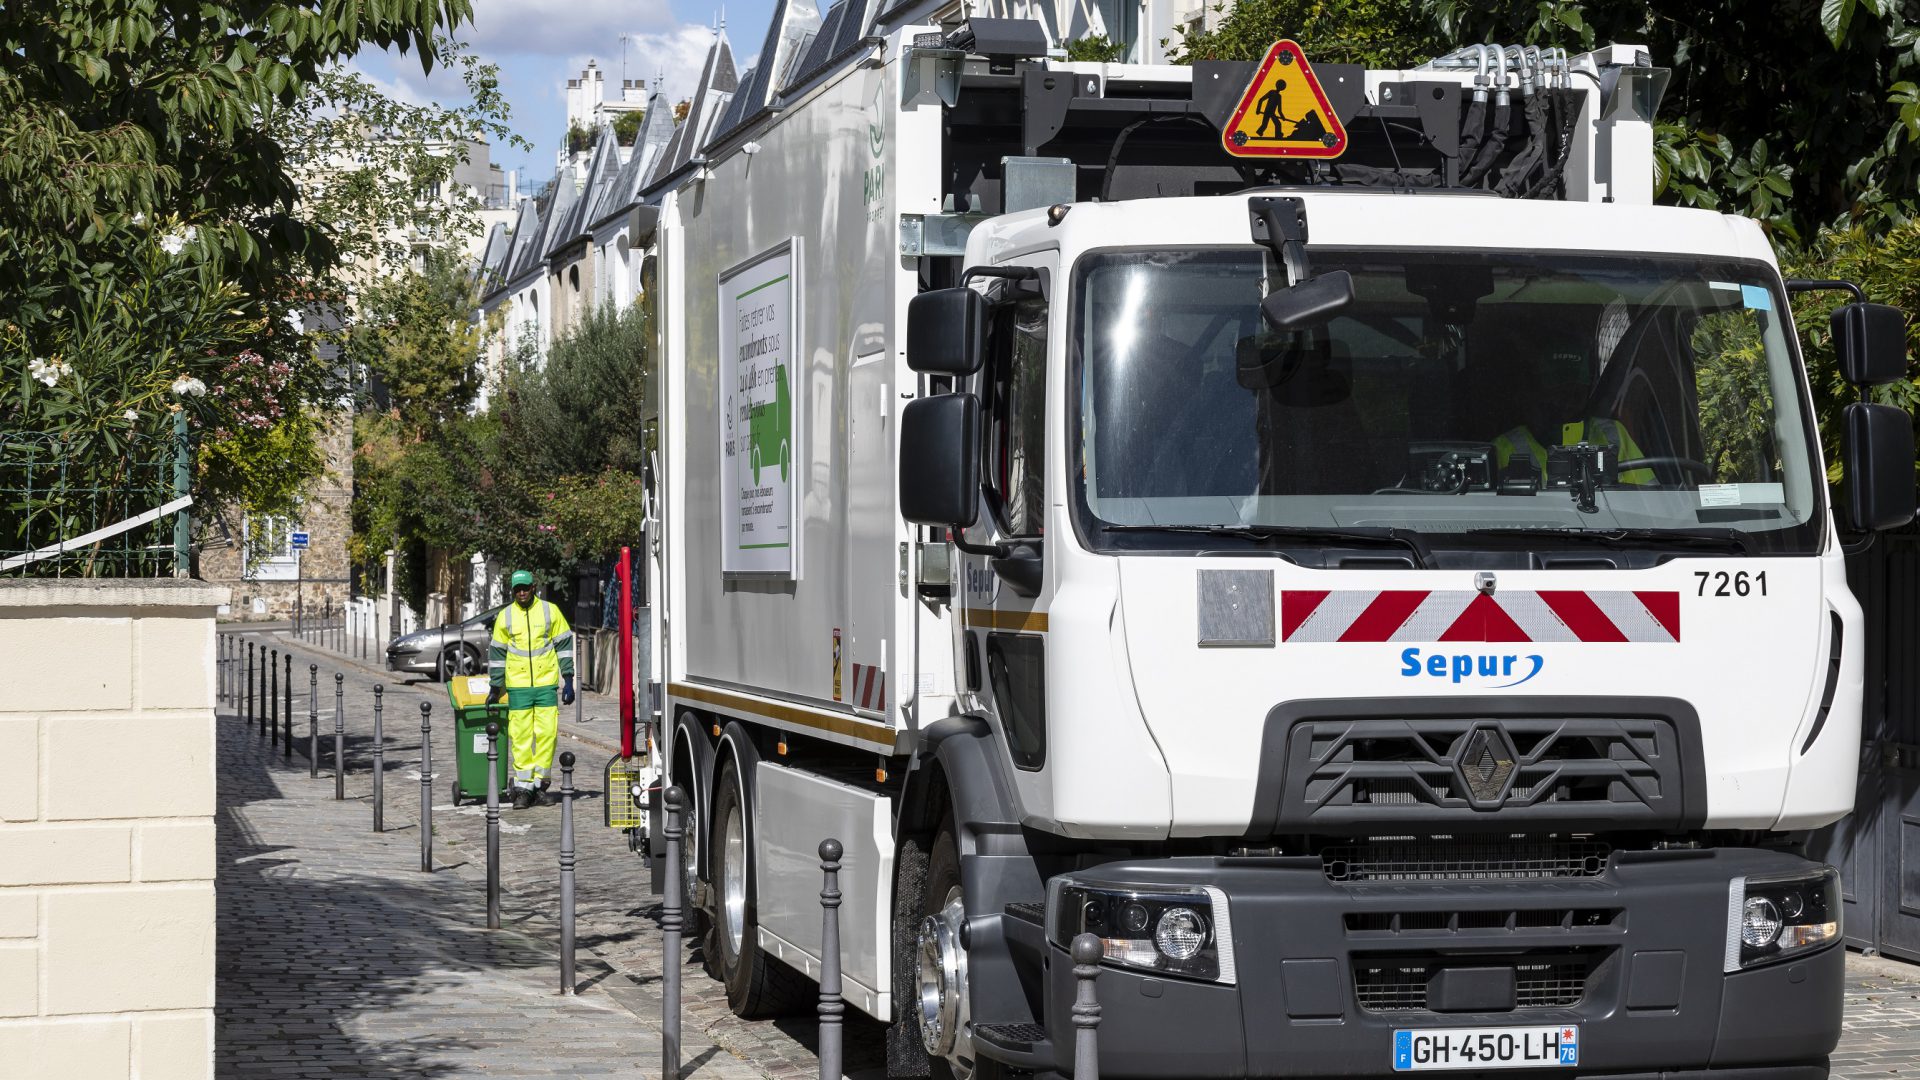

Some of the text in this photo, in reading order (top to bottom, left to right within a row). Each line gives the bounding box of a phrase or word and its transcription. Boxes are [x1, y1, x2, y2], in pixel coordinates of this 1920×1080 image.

[766, 304, 775, 321] vos
[967, 562, 995, 600] Sepur
[1694, 571, 1767, 597] 7261
[1401, 647, 1518, 683] Sepur
[1399, 1033, 1576, 1064] F GH-450-LH 78
